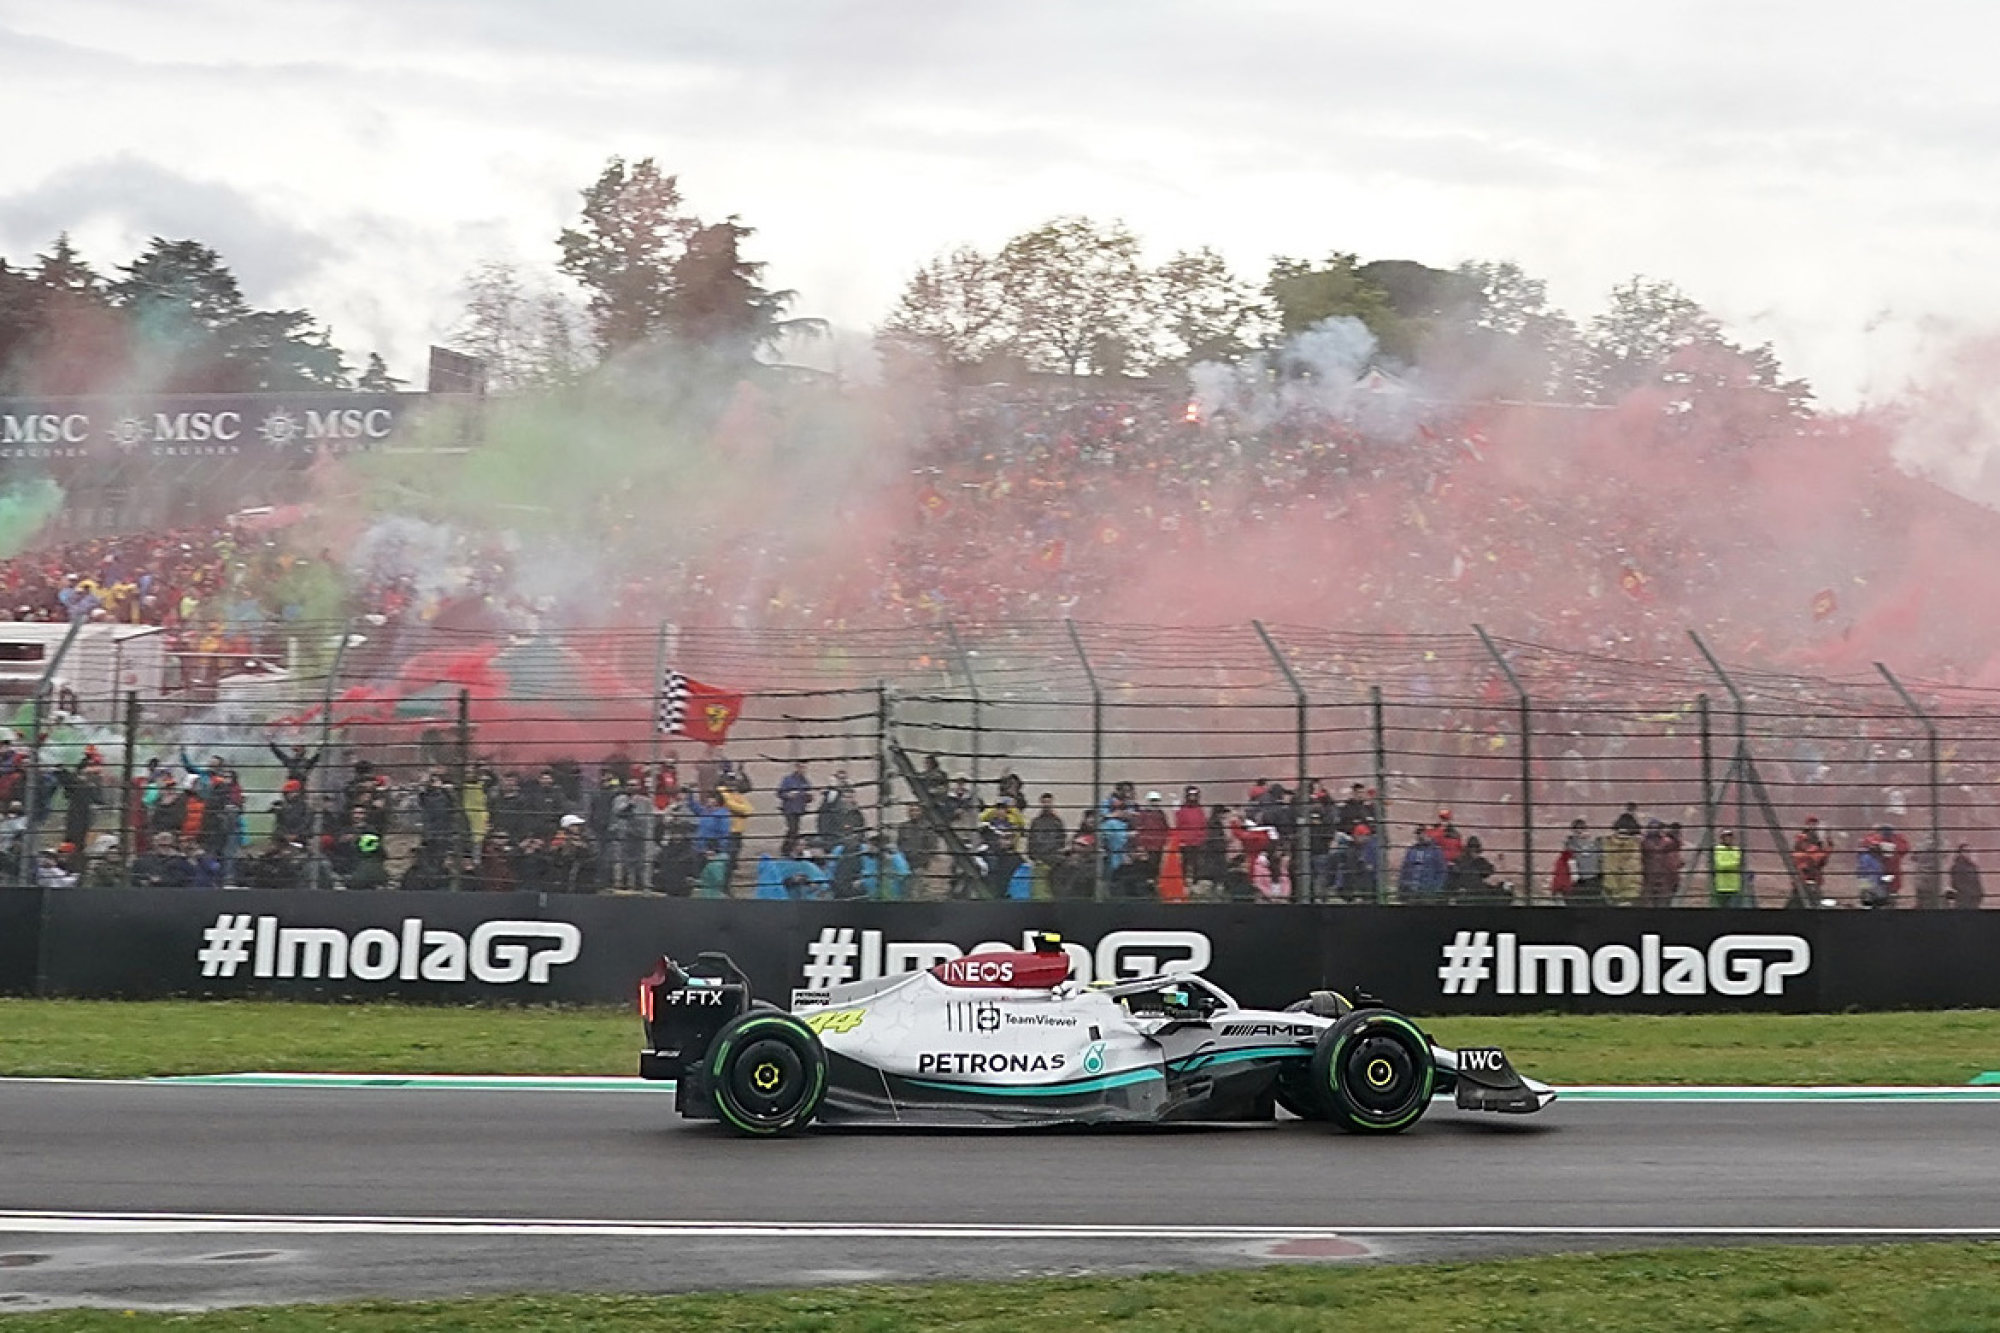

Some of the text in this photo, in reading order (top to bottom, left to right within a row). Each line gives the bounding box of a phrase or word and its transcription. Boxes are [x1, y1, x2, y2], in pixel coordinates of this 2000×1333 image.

[2, 414, 90, 443] MSC
[152, 412, 241, 441] MSC
[304, 409, 393, 438] MSC
[198, 914, 581, 983] #ImolaGP
[943, 961, 1013, 982] INEOS
[1438, 931, 1811, 995] #ImolaGP
[686, 990, 724, 1006] FTX
[804, 1008, 867, 1034] 44
[1004, 1012, 1078, 1028] TeamViewer
[1250, 1025, 1314, 1037] AMG
[918, 1053, 1066, 1074] PETRONAS
[1460, 1051, 1502, 1070] IWC
